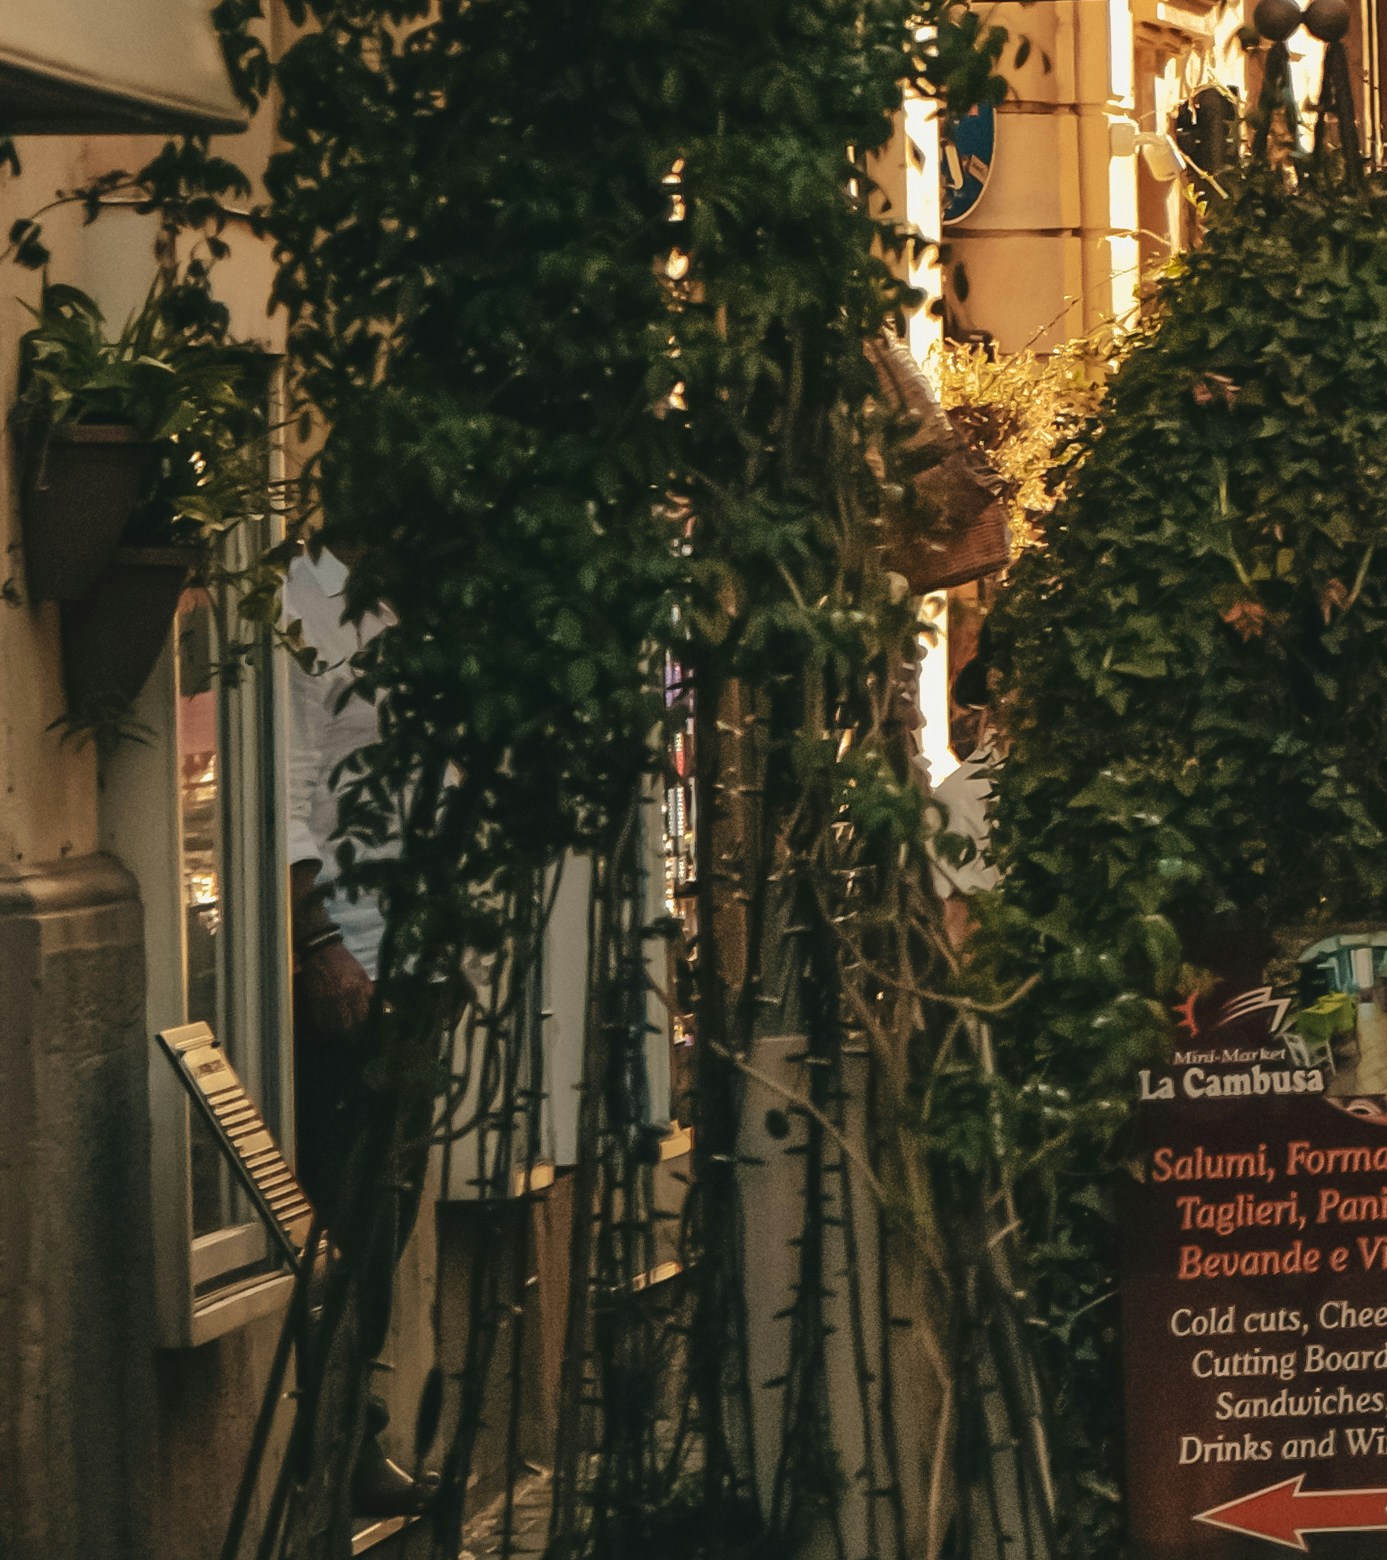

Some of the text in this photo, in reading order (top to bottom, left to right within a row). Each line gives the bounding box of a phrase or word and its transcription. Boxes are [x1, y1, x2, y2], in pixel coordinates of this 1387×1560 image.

[1172, 1047, 1287, 1066] Mini-Market
[1138, 1063, 1325, 1101] La Cambusa
[1152, 1142, 1277, 1183] Salumi,
[1175, 1190, 1307, 1237] Taglieri,
[1176, 1239, 1321, 1280] Bevande
[1329, 1246, 1350, 1273] e
[1170, 1304, 1236, 1337] Cold
[1243, 1307, 1310, 1337] cuts,
[1191, 1346, 1298, 1381] Cutting
[1178, 1432, 1274, 1465] Drinks
[1280, 1428, 1337, 1460] and
